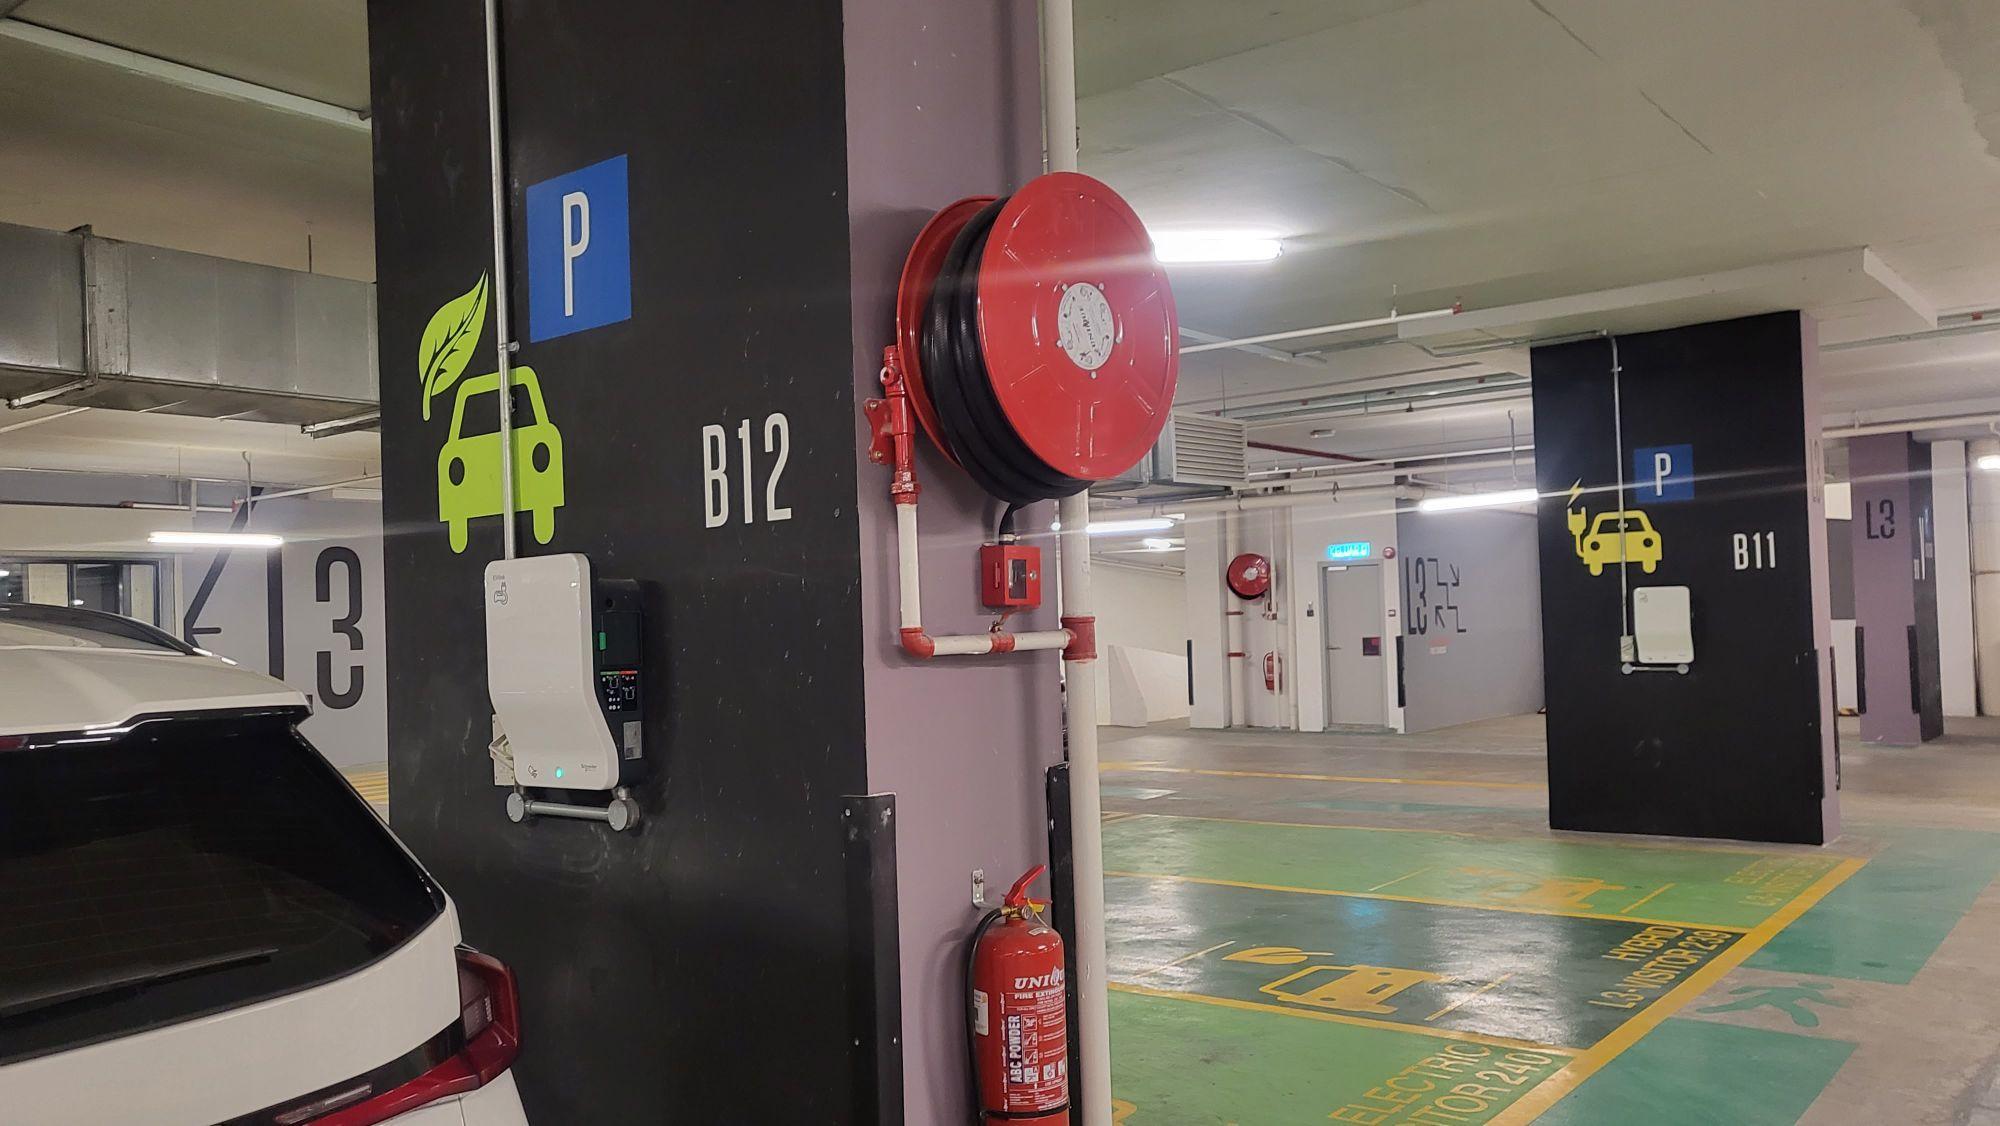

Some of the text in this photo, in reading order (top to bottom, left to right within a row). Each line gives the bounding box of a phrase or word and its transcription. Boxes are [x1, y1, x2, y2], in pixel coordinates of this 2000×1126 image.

[562, 191, 590, 317] P
[702, 412, 792, 529] B12
[1655, 452, 1672, 497] P
[1866, 499, 1896, 540] L3
[1733, 531, 1776, 570] B11
[1405, 557, 1428, 635] L3
[1601, 925, 1684, 962] HYBRID
[1677, 930, 1733, 951] 239
[1008, 1015, 1022, 1059] POWDER
[1010, 1061, 1023, 1083] ABC
[1328, 1043, 1492, 1126] ELECTRIC
[1475, 1052, 1553, 1086] 240
